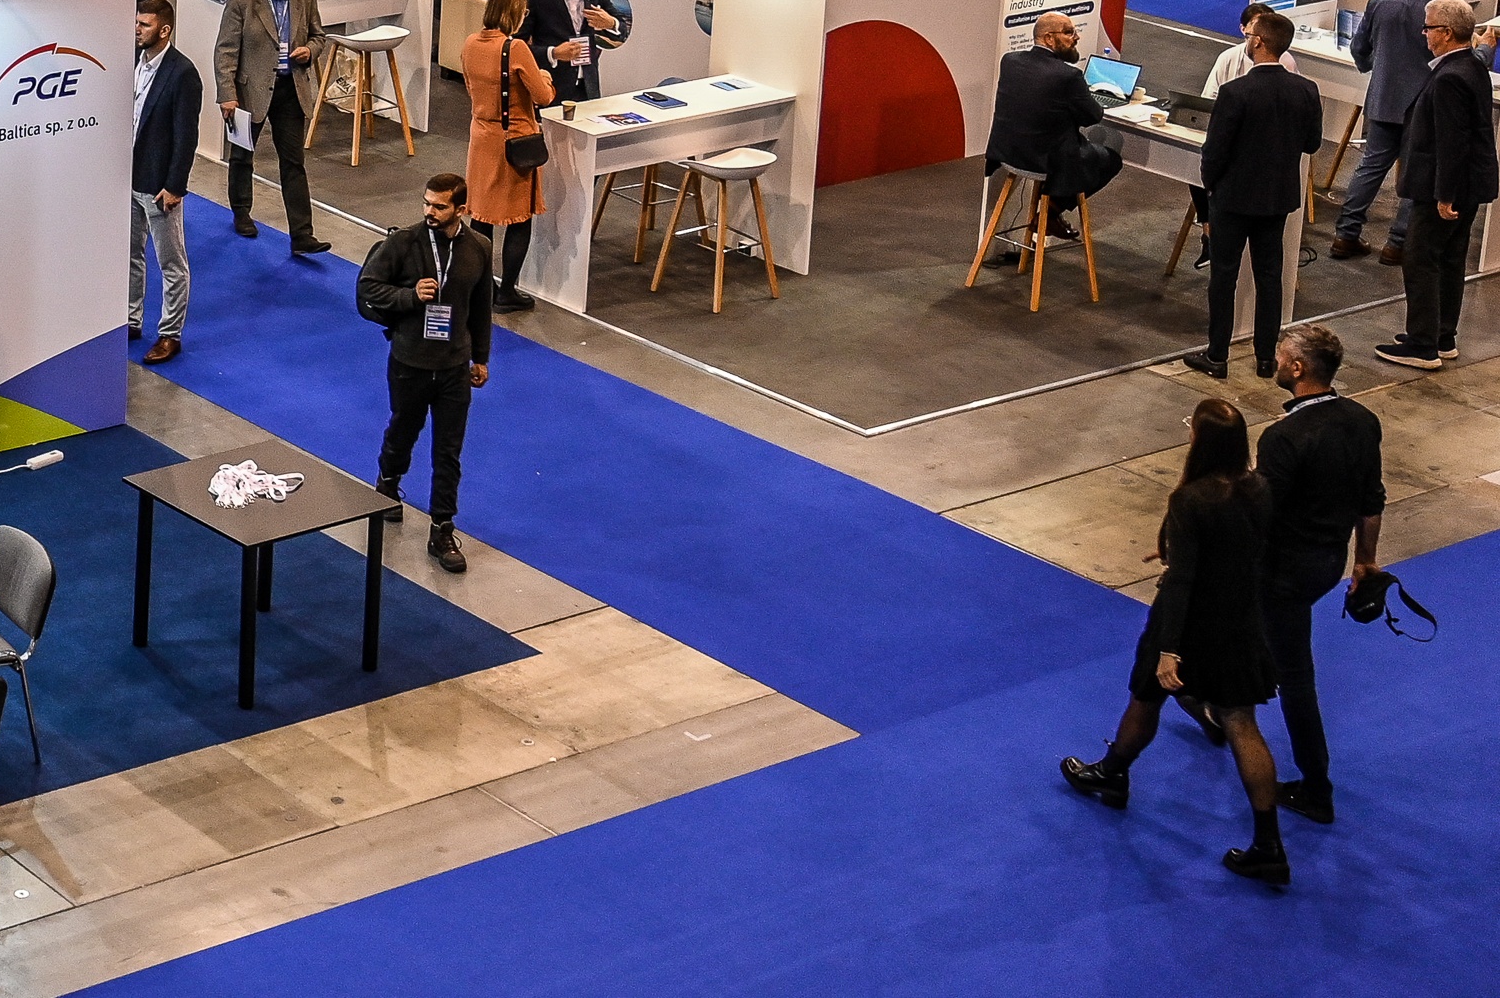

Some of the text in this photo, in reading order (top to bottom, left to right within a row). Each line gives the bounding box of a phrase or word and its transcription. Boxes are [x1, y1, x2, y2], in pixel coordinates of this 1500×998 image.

[11, 68, 83, 106] PGE
[45, 121, 64, 136] sp.
[67, 119, 74, 130] z
[77, 116, 99, 129] o.o.
